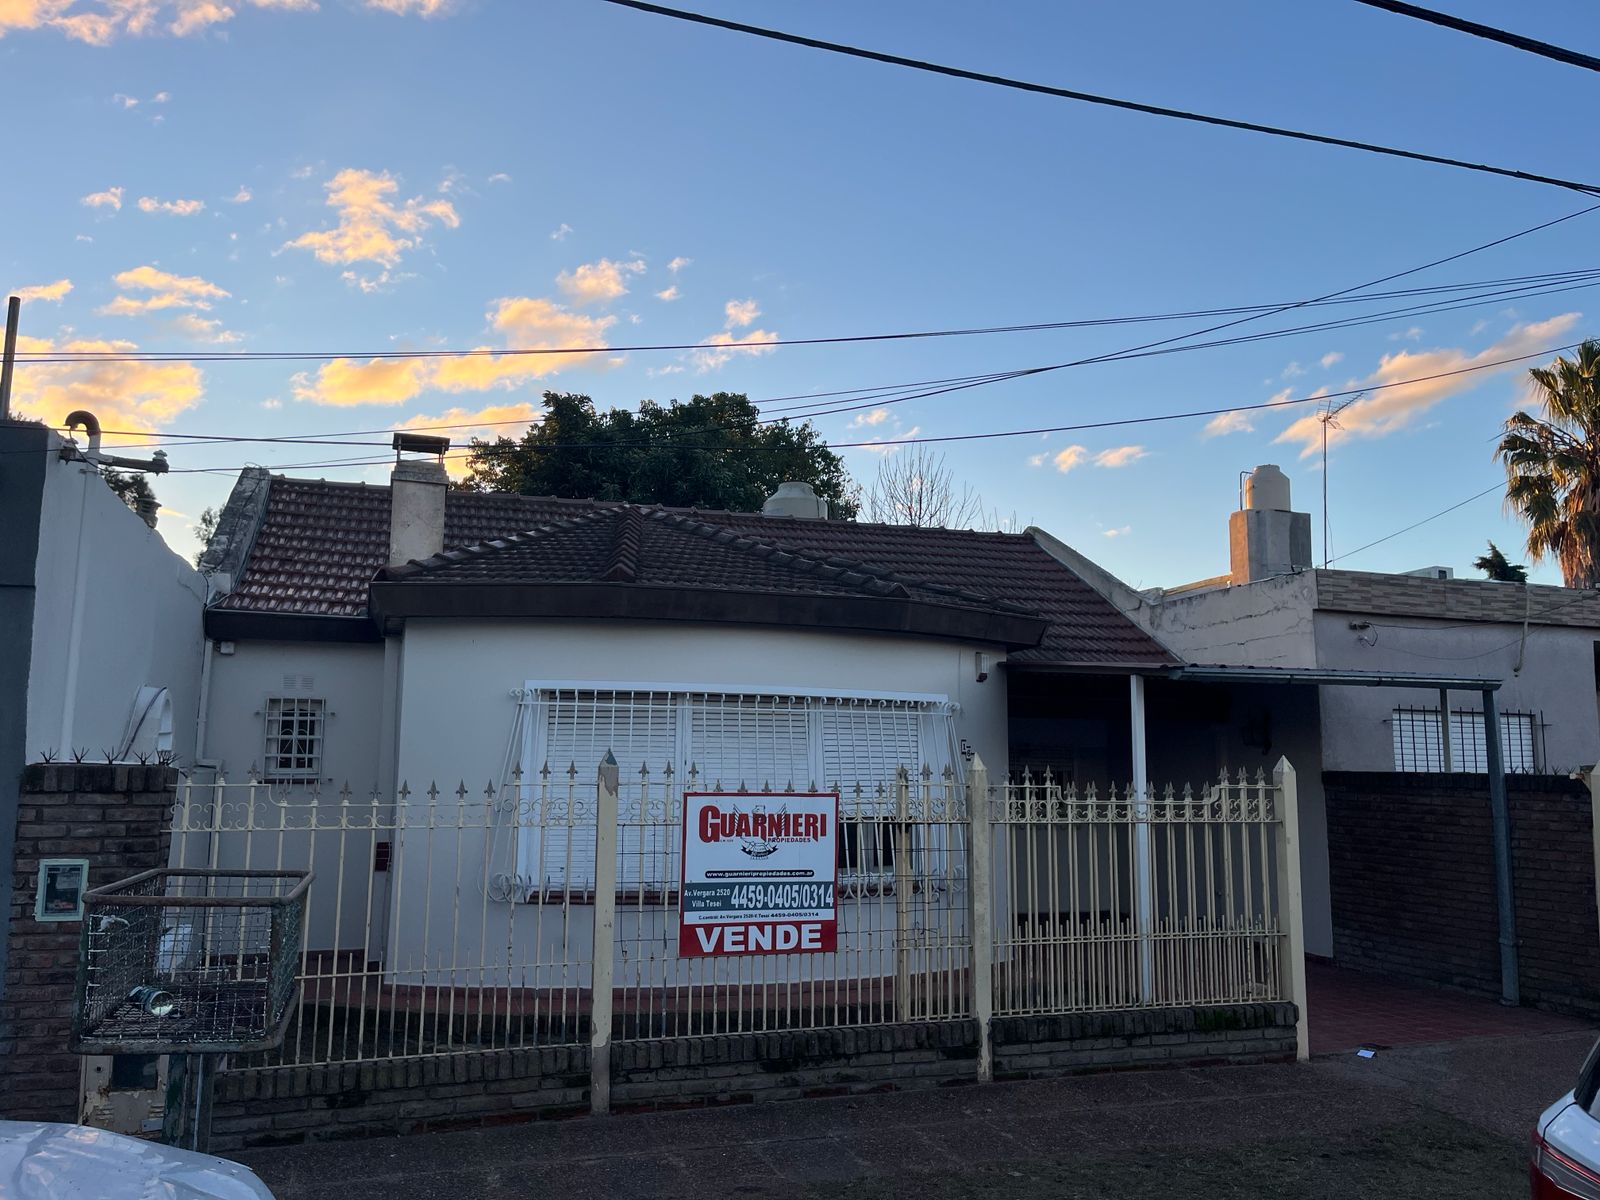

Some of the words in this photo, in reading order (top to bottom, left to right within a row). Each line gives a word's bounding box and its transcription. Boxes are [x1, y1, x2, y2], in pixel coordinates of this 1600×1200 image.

[699, 805, 827, 843] GUARNIERI
[706, 870, 813, 878] www.guarnieripropiedades.com.ar
[716, 888, 731, 896] 2520
[730, 884, 834, 909] 4459-0405/0314
[695, 923, 822, 953] VENDE
